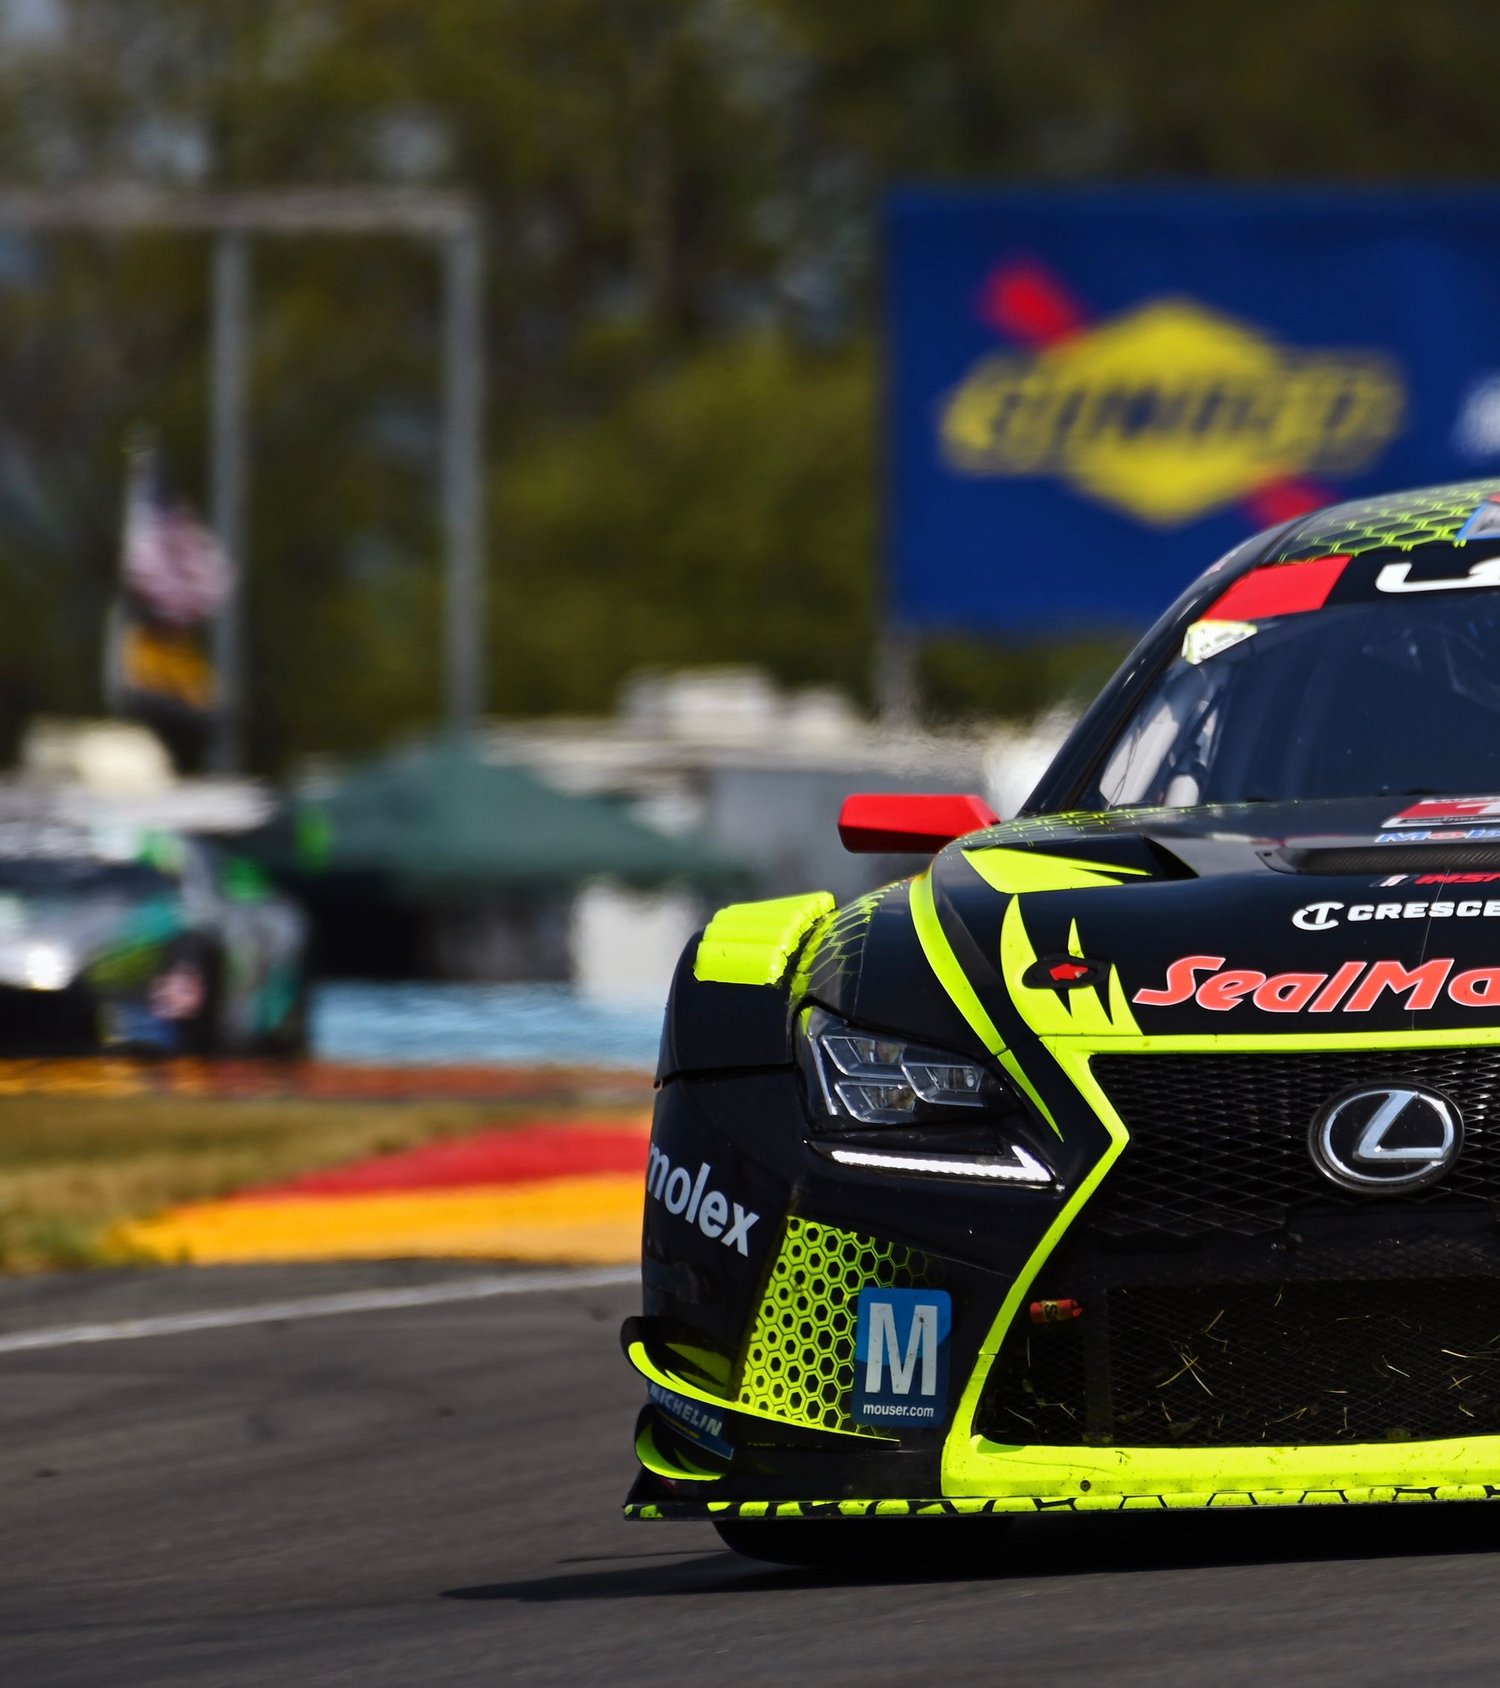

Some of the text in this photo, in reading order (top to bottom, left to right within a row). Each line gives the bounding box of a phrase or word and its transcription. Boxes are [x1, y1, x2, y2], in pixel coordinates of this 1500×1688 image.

[647, 1142, 760, 1257] molex
[865, 1302, 938, 1396] M
[649, 1384, 722, 1437] MICHELIN
[863, 1403, 935, 1418] mouser.com
